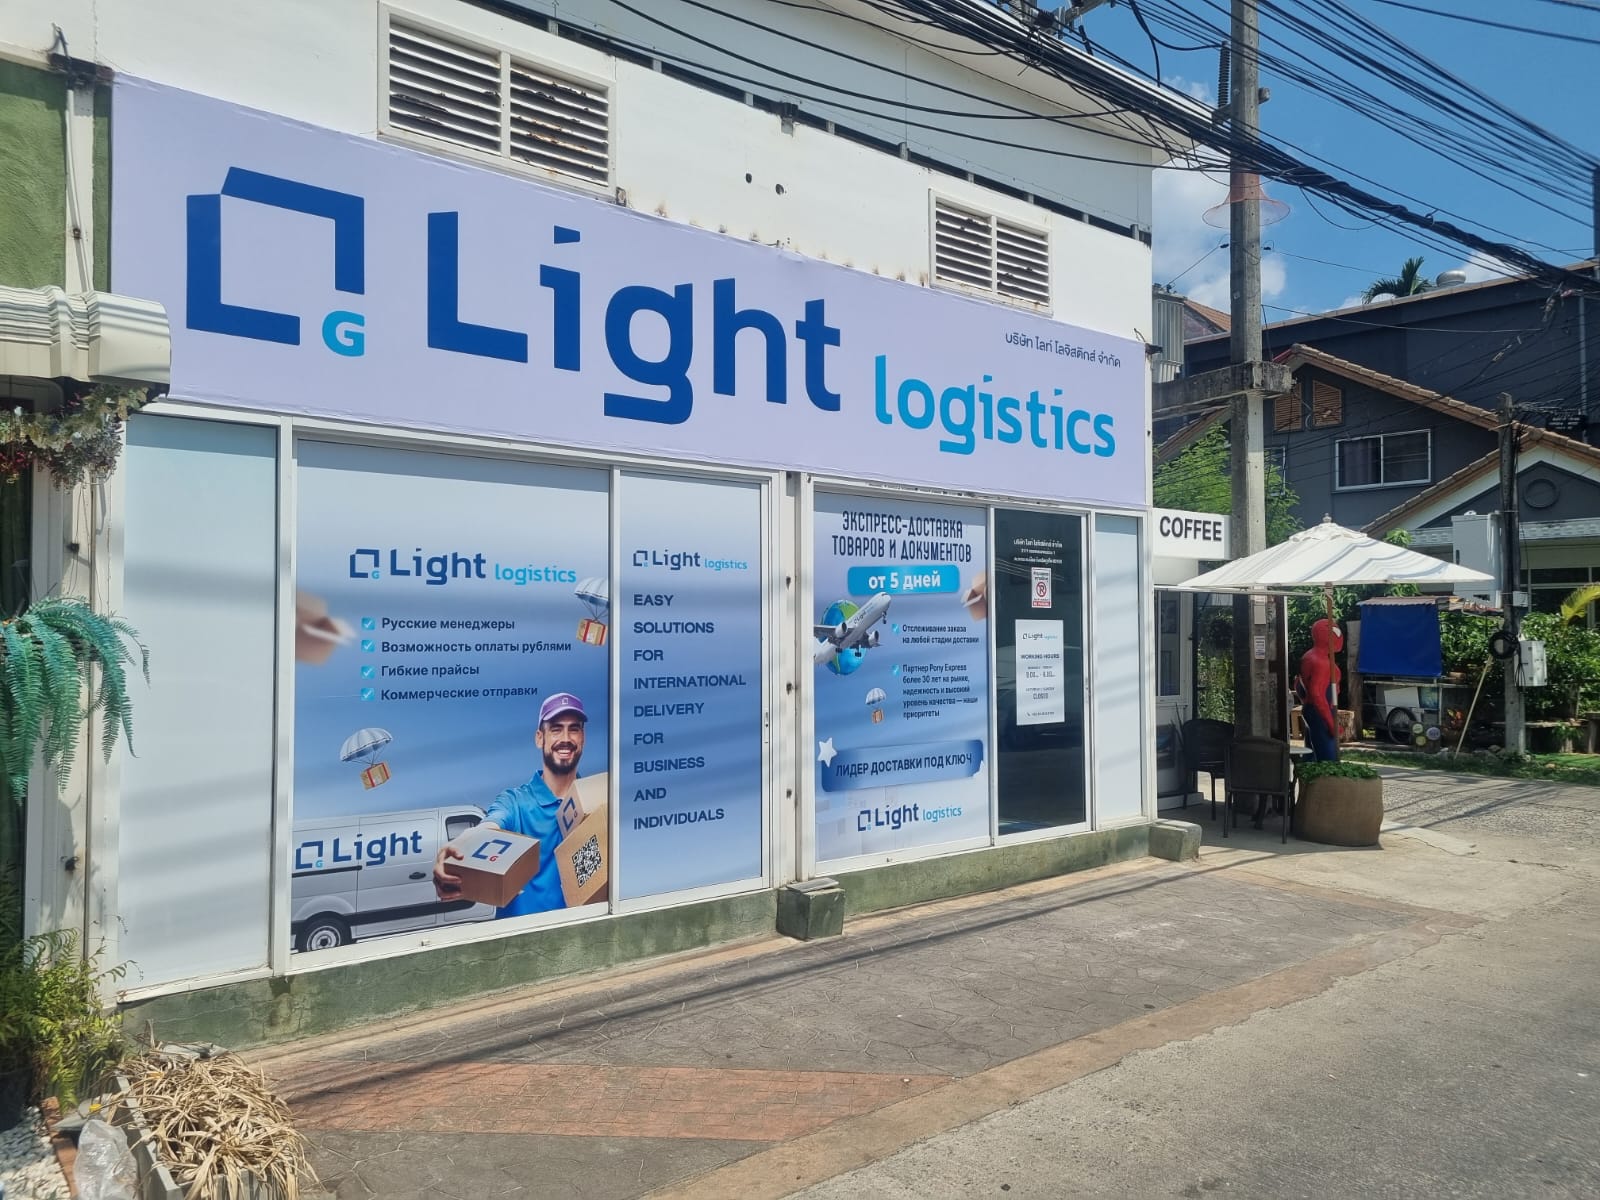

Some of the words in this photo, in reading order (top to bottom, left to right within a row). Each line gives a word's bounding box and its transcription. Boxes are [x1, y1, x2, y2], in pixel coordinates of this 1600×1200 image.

[427, 211, 841, 425] Light
[875, 355, 1116, 458] logistics
[1005, 332, 1033, 349] บริษัท
[1035, 335, 1053, 352] ไลท์
[1054, 339, 1096, 362] โลจิสติกส์
[1098, 350, 1121, 368] จำกัด
[842, 510, 963, 539] ЭКСПРЕСС-ДОСТАВКА
[1159, 515, 1222, 542] COFFEE
[832, 534, 885, 558] ТОВАРОВ
[889, 541, 896, 559] И
[900, 540, 972, 562] ДОКУМЕНТОВ
[390, 548, 486, 585] Light
[495, 563, 577, 585] logistics
[652, 549, 701, 571] Light
[704, 558, 748, 571] logistics
[868, 575, 886, 589] от
[890, 573, 899, 589] 5
[902, 570, 941, 590] дней
[633, 594, 674, 607] EASY
[381, 617, 437, 630] Русские
[440, 618, 515, 631] менеджеры
[633, 622, 715, 634] SOLUTIONS
[381, 640, 472, 653] Возможность
[475, 641, 519, 652] оплаты
[522, 640, 572, 654] рублями
[633, 650, 664, 662] FOR
[381, 664, 428, 676] Гибкие
[431, 663, 480, 678] прайсы
[922, 675, 930, 683] 30
[633, 674, 747, 689] INTERNATIONAL
[381, 688, 480, 701] Коммерческие
[482, 685, 538, 699] отправки
[633, 703, 705, 717] DELIVERY
[633, 732, 664, 746] FOR
[633, 756, 705, 773] BUSINESS
[836, 762, 869, 778] ЛИДЕР
[870, 757, 922, 776] ДОСТАВКИ
[923, 755, 944, 769] ПОД
[945, 753, 972, 766] КЛЮЧ
[633, 787, 667, 801] AND
[633, 808, 725, 830] INDIVIDUALS
[875, 803, 919, 830] Light
[922, 806, 962, 823] logistics
[333, 830, 423, 867] Light
